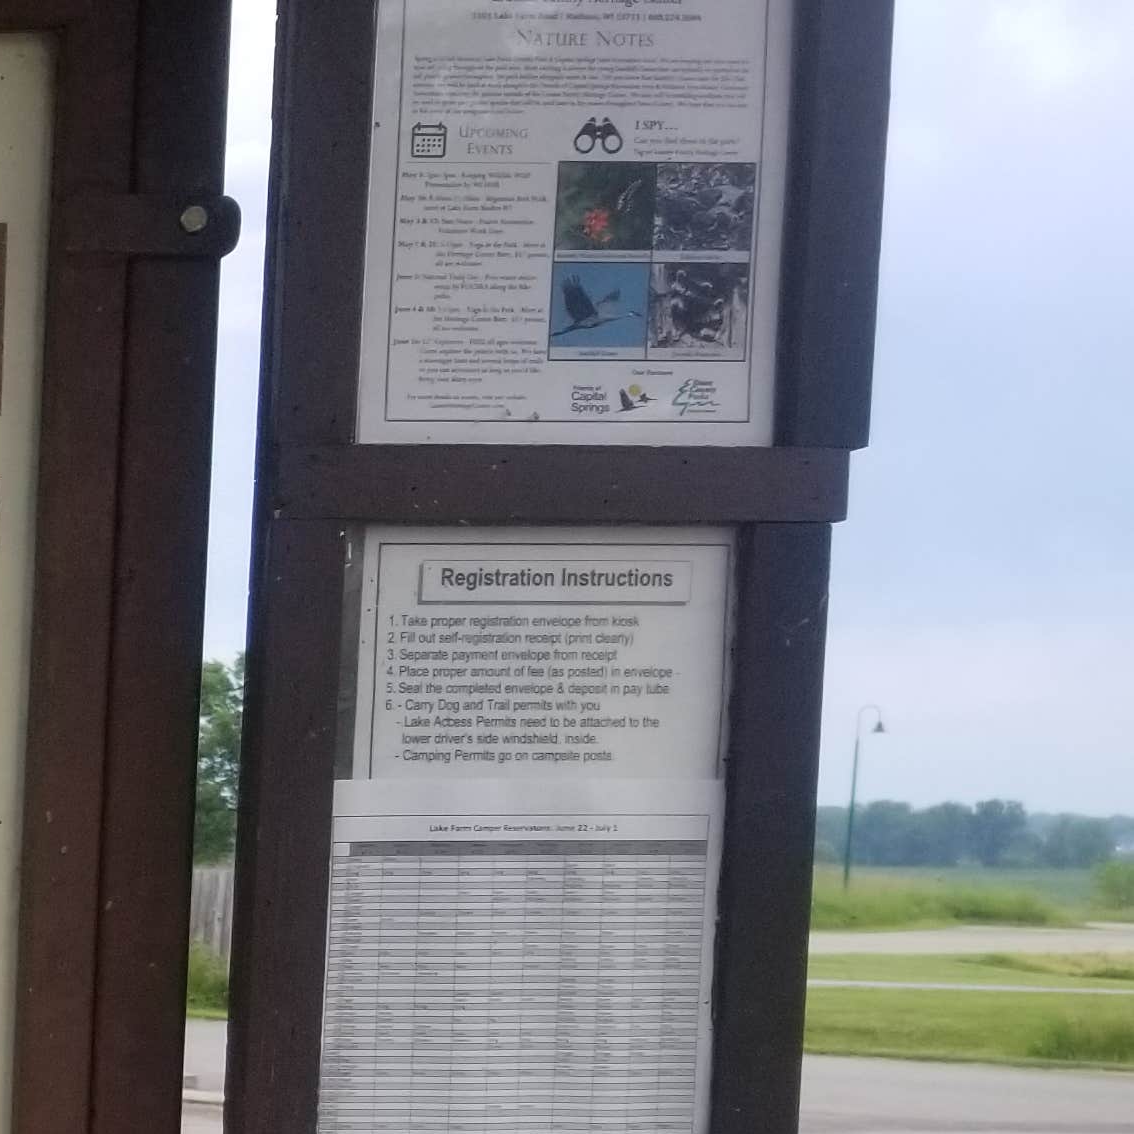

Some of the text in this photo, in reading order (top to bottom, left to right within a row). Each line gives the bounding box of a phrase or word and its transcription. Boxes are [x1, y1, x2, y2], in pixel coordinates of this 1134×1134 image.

[516, 29, 654, 48] NATURE NOTES
[466, 141, 513, 156] EVENTS
[571, 391, 607, 402] Capital
[571, 403, 610, 414] Springs
[441, 567, 674, 590] Registration Instructions
[402, 615, 427, 627] Take
[431, 617, 466, 629] proper
[469, 615, 529, 629] registration
[532, 615, 581, 629] envelope
[584, 615, 609, 627] from
[612, 615, 640, 627] kiosk
[399, 649, 448, 662] Separate
[452, 651, 498, 663] payment
[501, 650, 551, 663] envelope
[554, 650, 579, 661] from
[581, 650, 617, 663] receipt
[405, 700, 434, 714] Carry
[438, 700, 460, 714] Dog
[463, 700, 483, 711] and
[488, 700, 510, 711] Trail
[513, 700, 553, 714] permits
[555, 700, 577, 711] with
[580, 702, 601, 714] you
